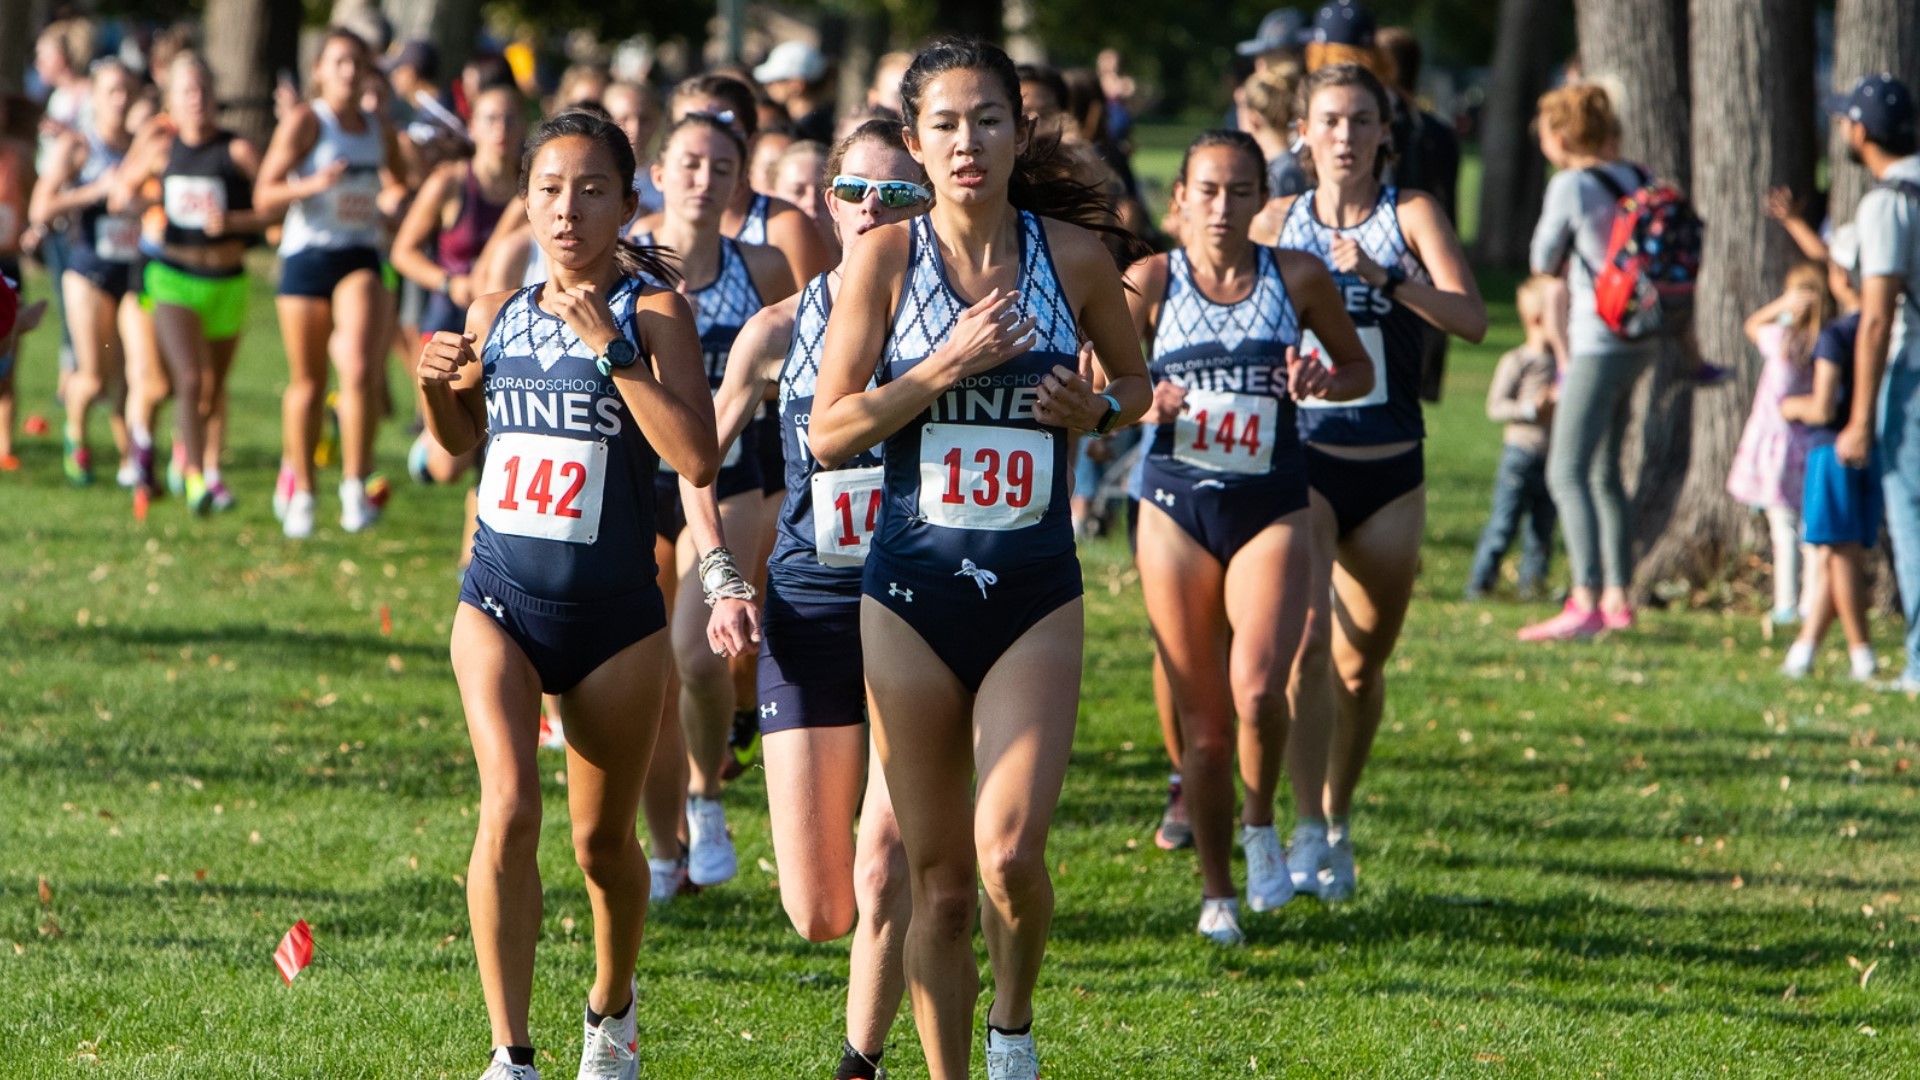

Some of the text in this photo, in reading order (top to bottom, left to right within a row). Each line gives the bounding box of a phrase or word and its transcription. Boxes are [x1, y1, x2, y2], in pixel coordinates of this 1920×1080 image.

[929, 387, 1038, 422] INE
[1168, 365, 1287, 398] MINES
[485, 390, 622, 436] MINES
[1191, 409, 1262, 456] 144
[498, 455, 587, 519] 142
[941, 447, 1034, 508] 139
[834, 488, 883, 546] 14
